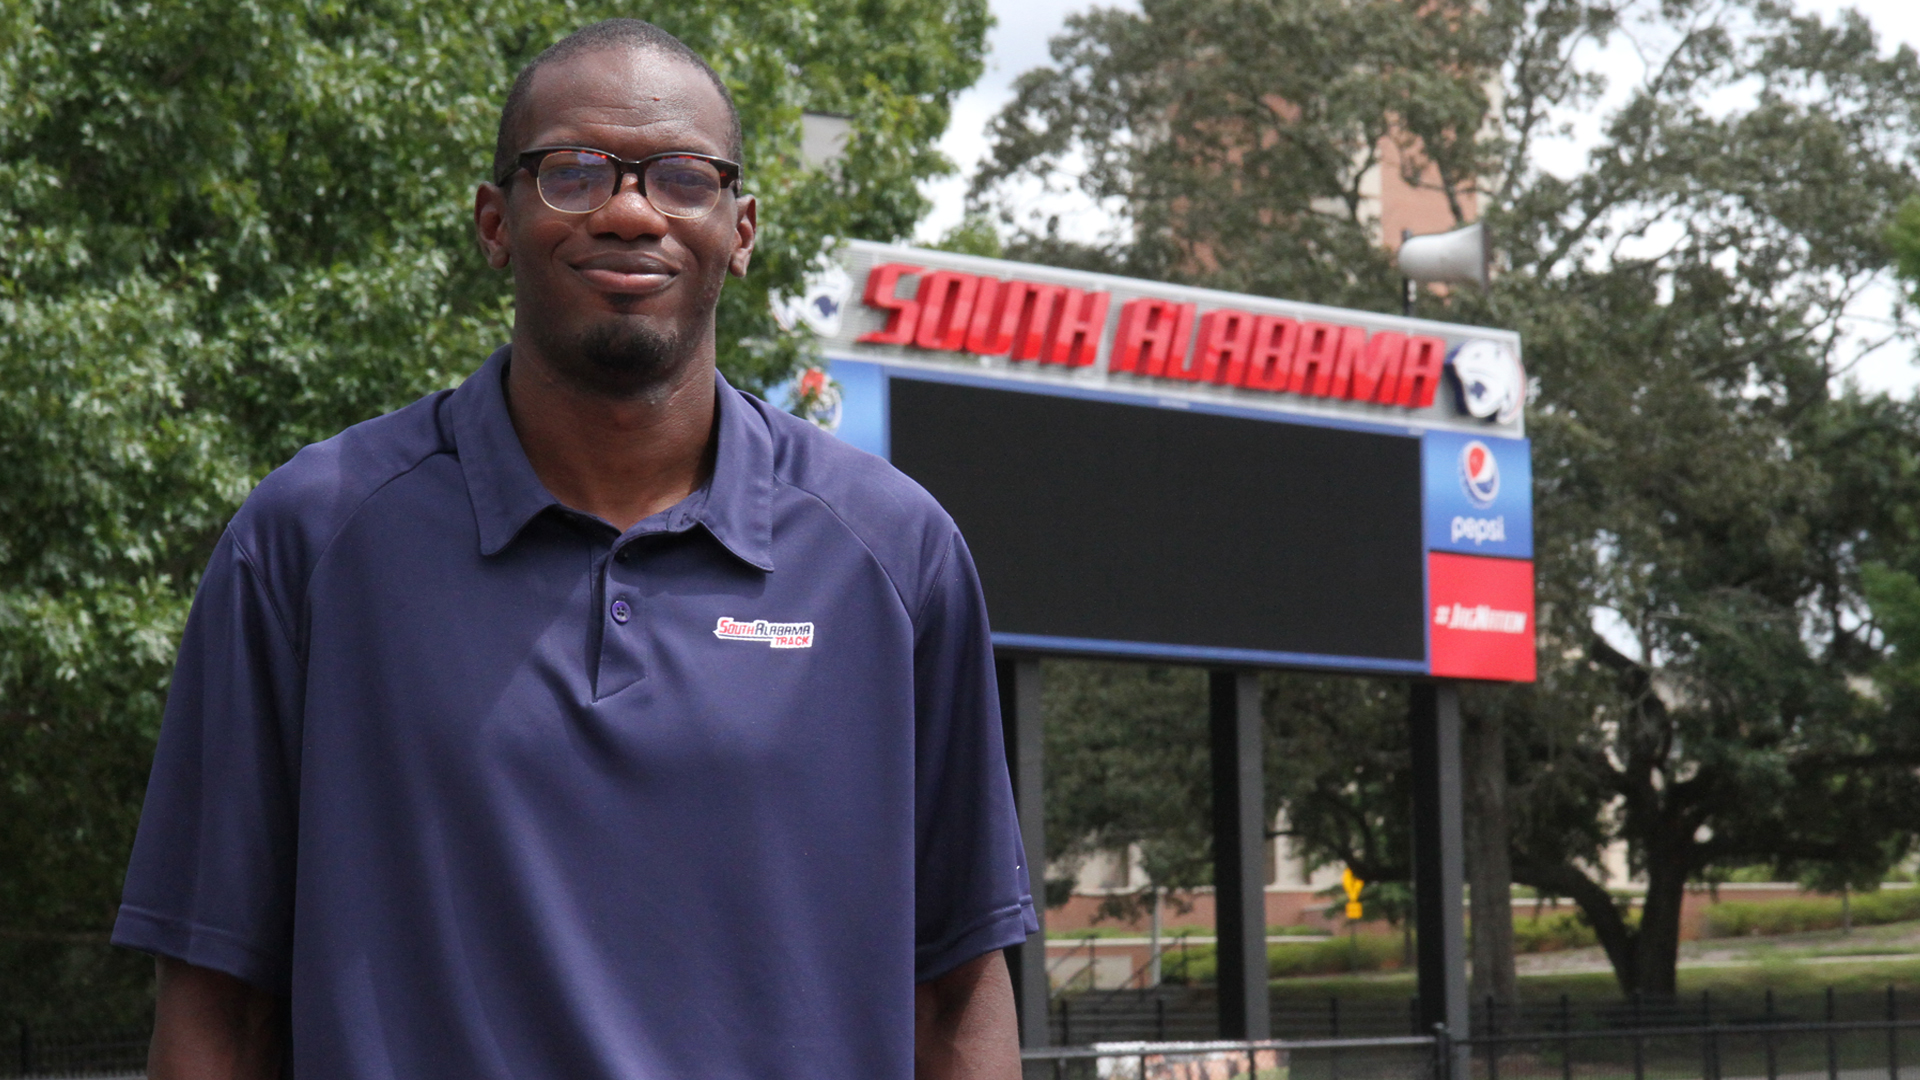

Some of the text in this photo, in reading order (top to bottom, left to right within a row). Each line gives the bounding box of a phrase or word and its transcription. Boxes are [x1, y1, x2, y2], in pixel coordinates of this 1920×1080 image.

[855, 262, 1446, 409] SOUTH ALABAMA
[1451, 515, 1505, 545] pepsi
[775, 636, 810, 646] TRACK
